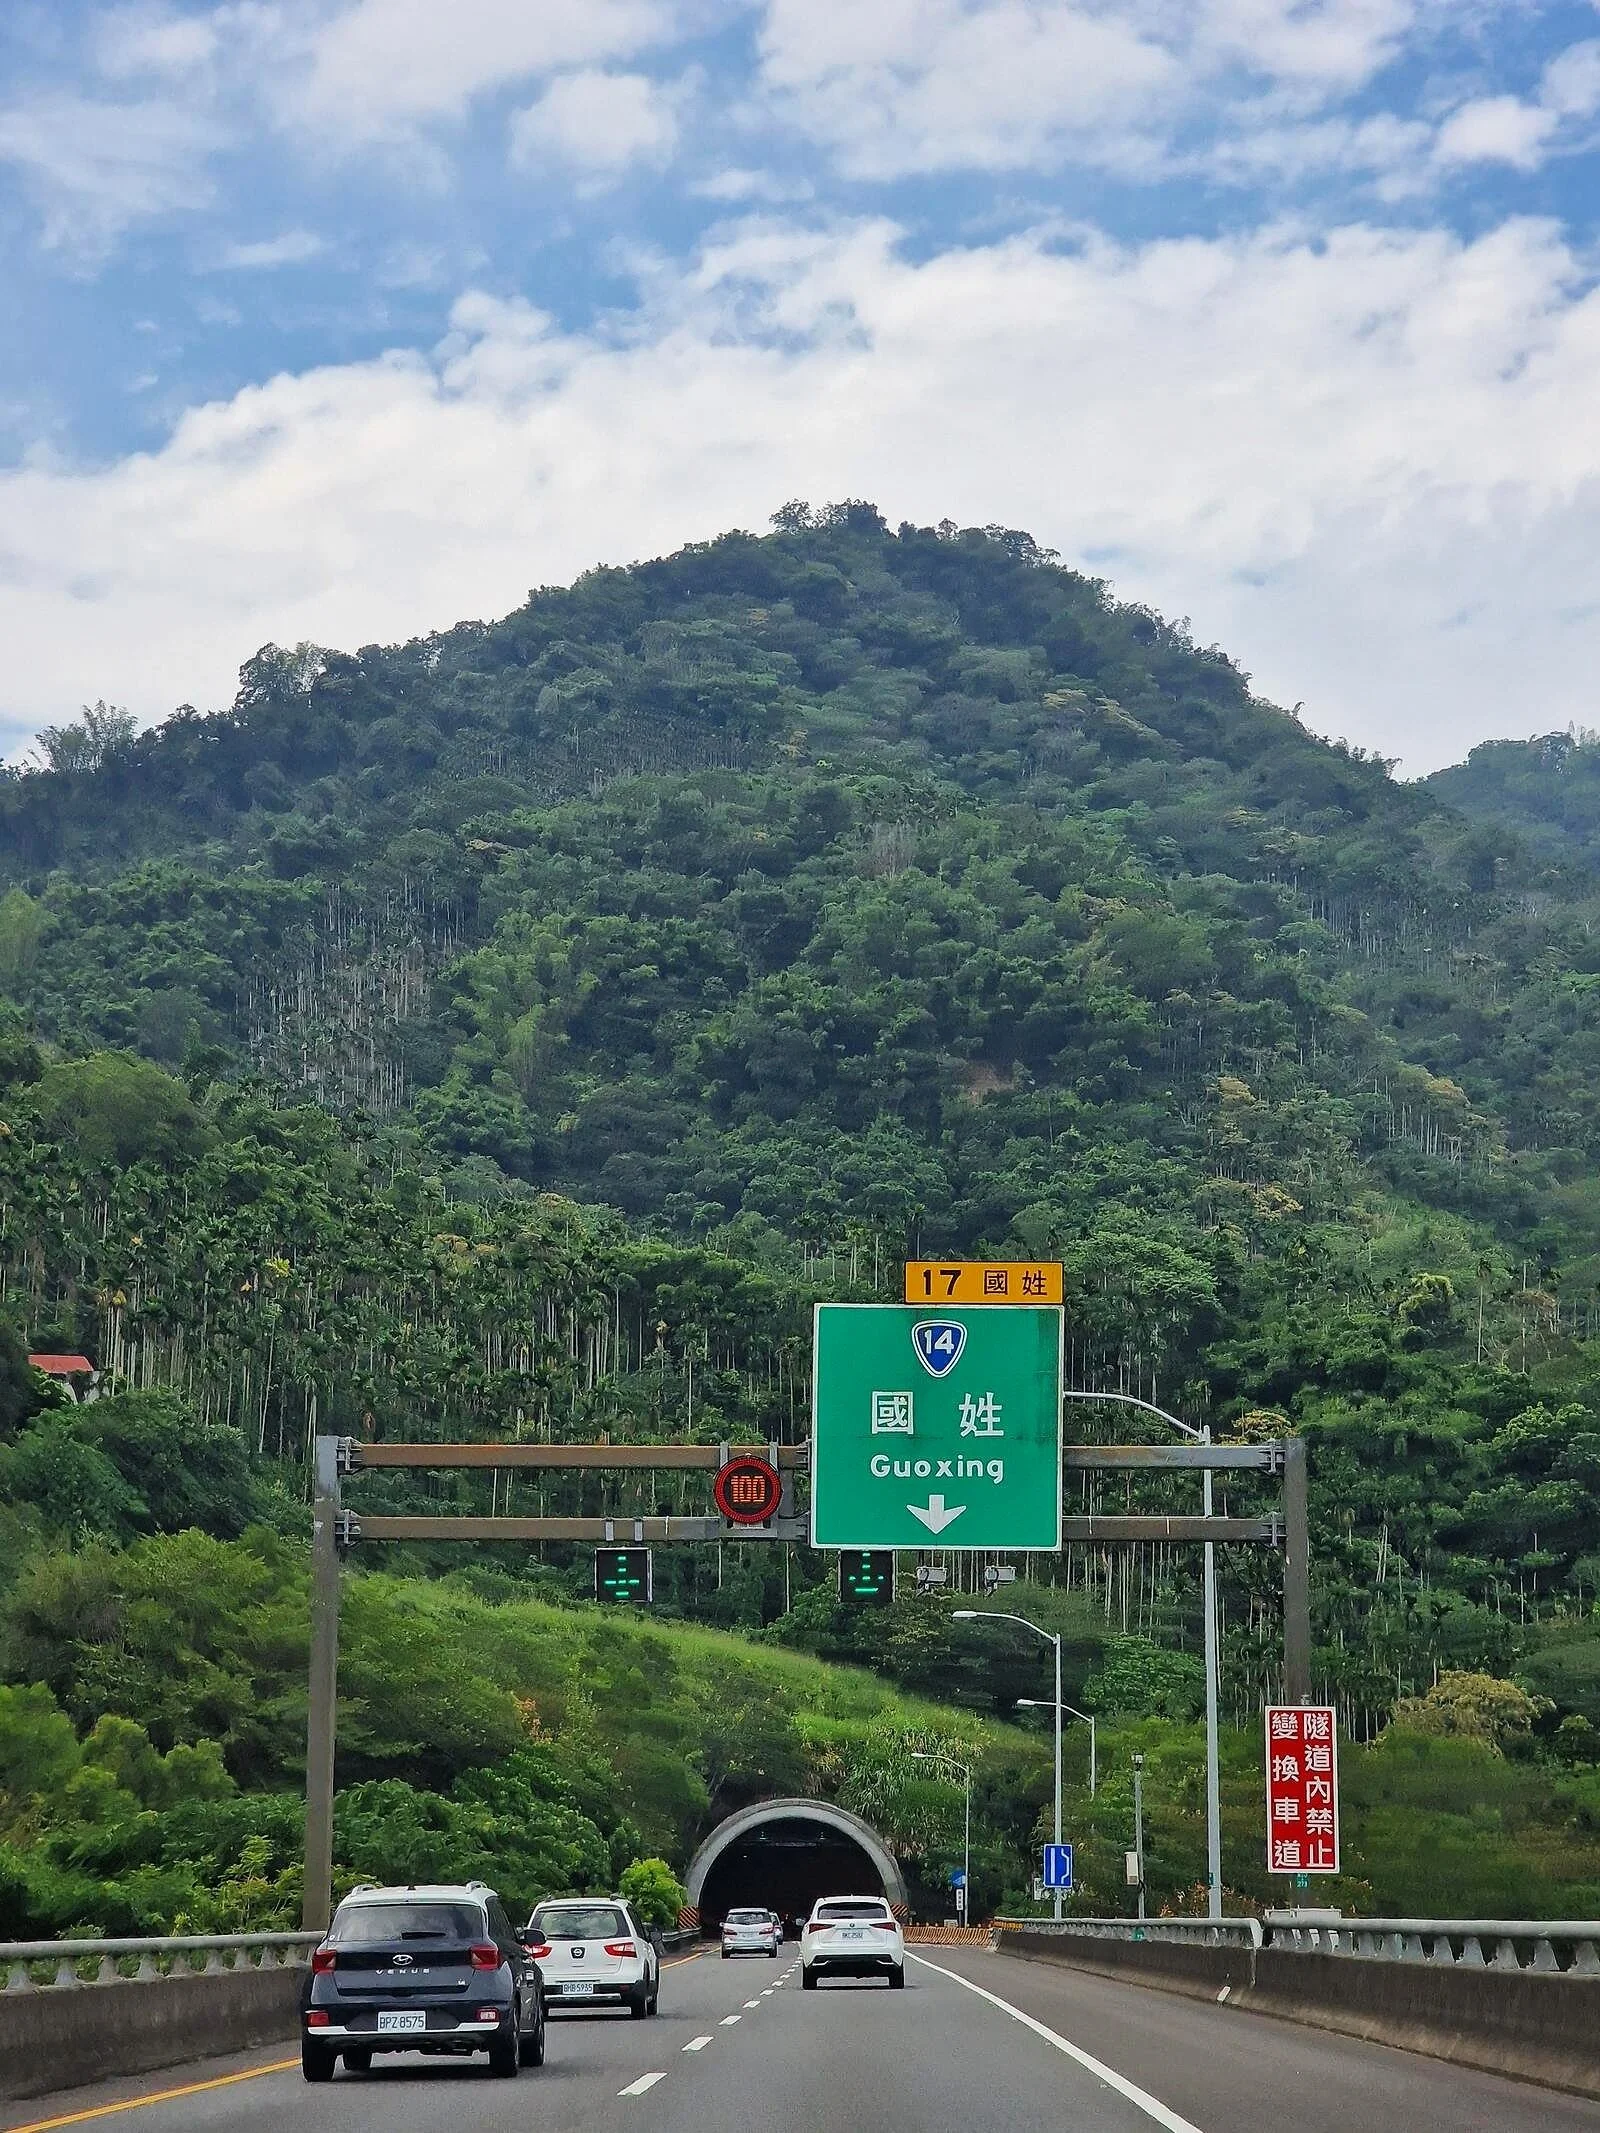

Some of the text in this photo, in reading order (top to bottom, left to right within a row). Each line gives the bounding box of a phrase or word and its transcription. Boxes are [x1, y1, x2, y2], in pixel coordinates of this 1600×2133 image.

[922, 1269, 1048, 1297] 17 國姓
[924, 1329, 955, 1355] 14
[871, 1391, 1005, 1438] 國姓
[870, 1454, 1005, 1484] Guoxing
[731, 1475, 765, 1502] 100
[1271, 1712, 1301, 1868] 變換車道
[1304, 1713, 1333, 1868] 隧道內禁止
